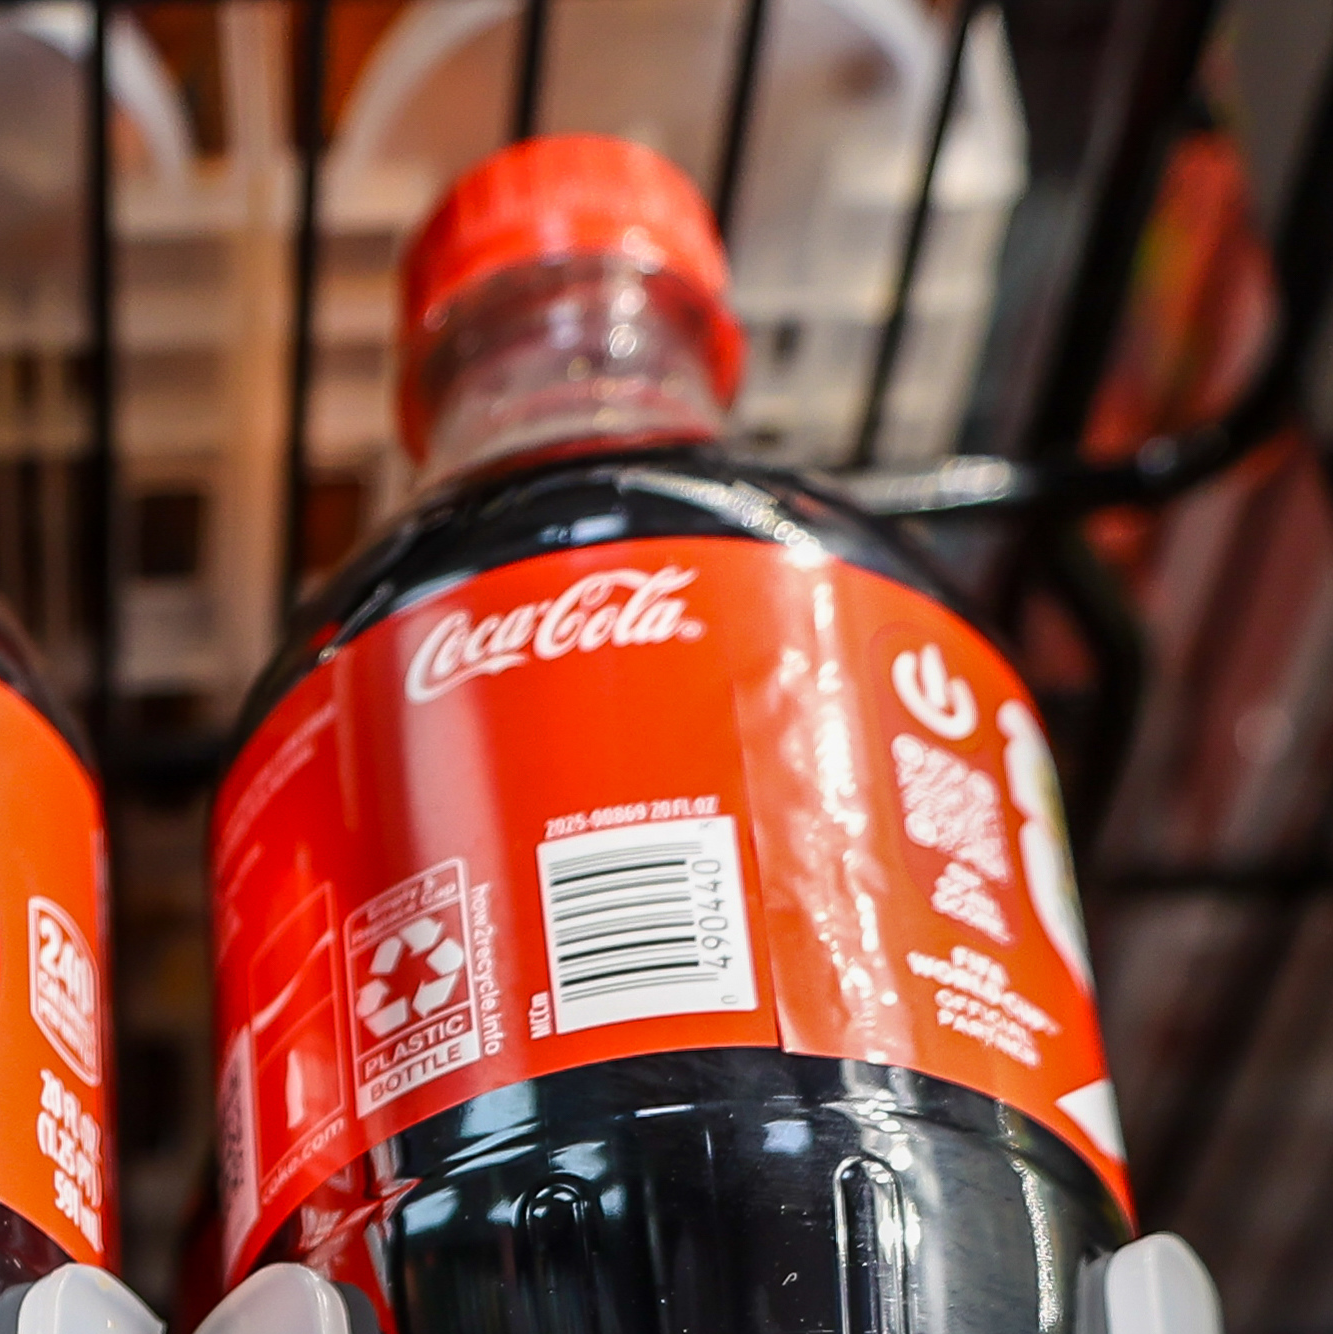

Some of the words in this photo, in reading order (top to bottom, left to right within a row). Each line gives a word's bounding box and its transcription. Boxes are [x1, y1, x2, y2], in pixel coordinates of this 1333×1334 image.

[404, 565, 699, 706] Coca-Cola
[672, 797, 691, 816] FL
[470, 880, 505, 1058] how2recycle.info
[364, 1013, 465, 1081] PLASTIC
[369, 1041, 463, 1103] BOTTLE
